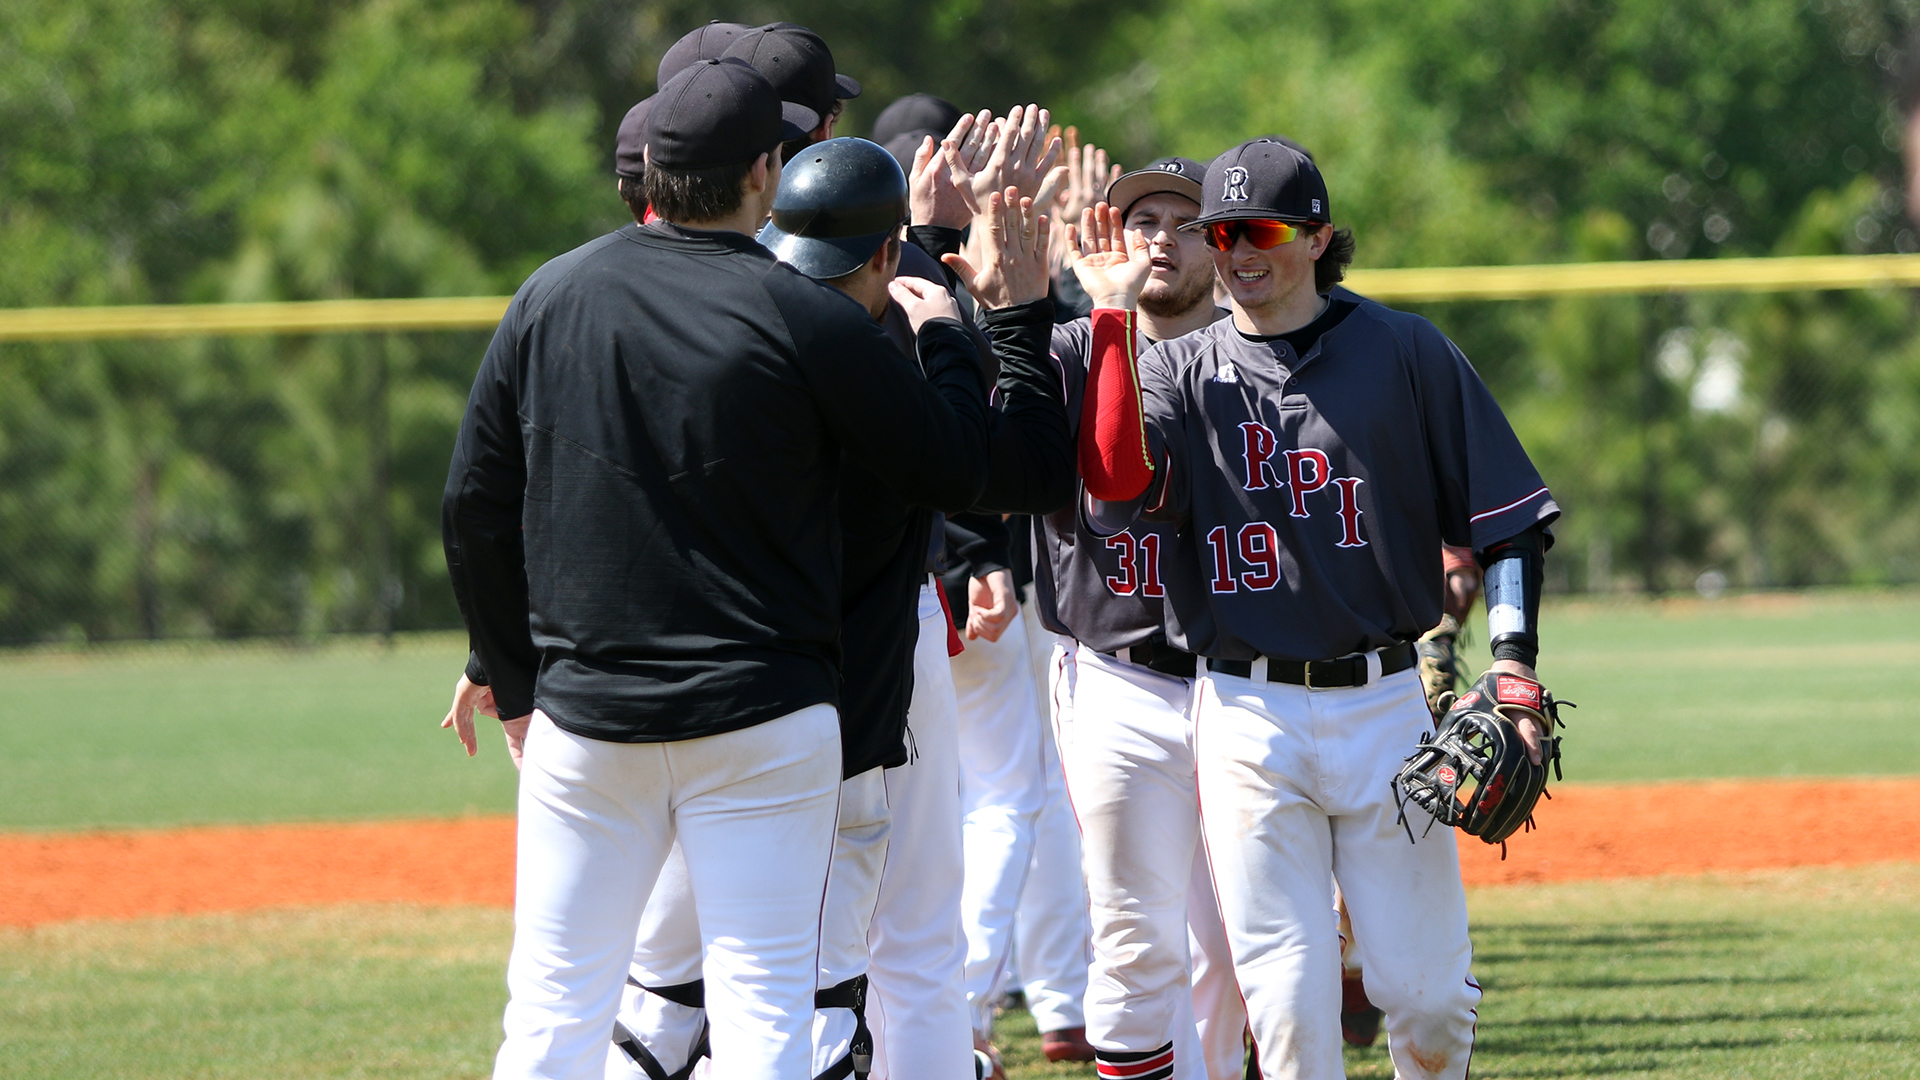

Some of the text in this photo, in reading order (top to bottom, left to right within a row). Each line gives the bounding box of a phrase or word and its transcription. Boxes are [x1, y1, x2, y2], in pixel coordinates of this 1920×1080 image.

[1222, 166, 1249, 202] R
[1237, 421, 1369, 548] RPI
[1105, 531, 1165, 597] 31
[1207, 521, 1281, 594] 19
